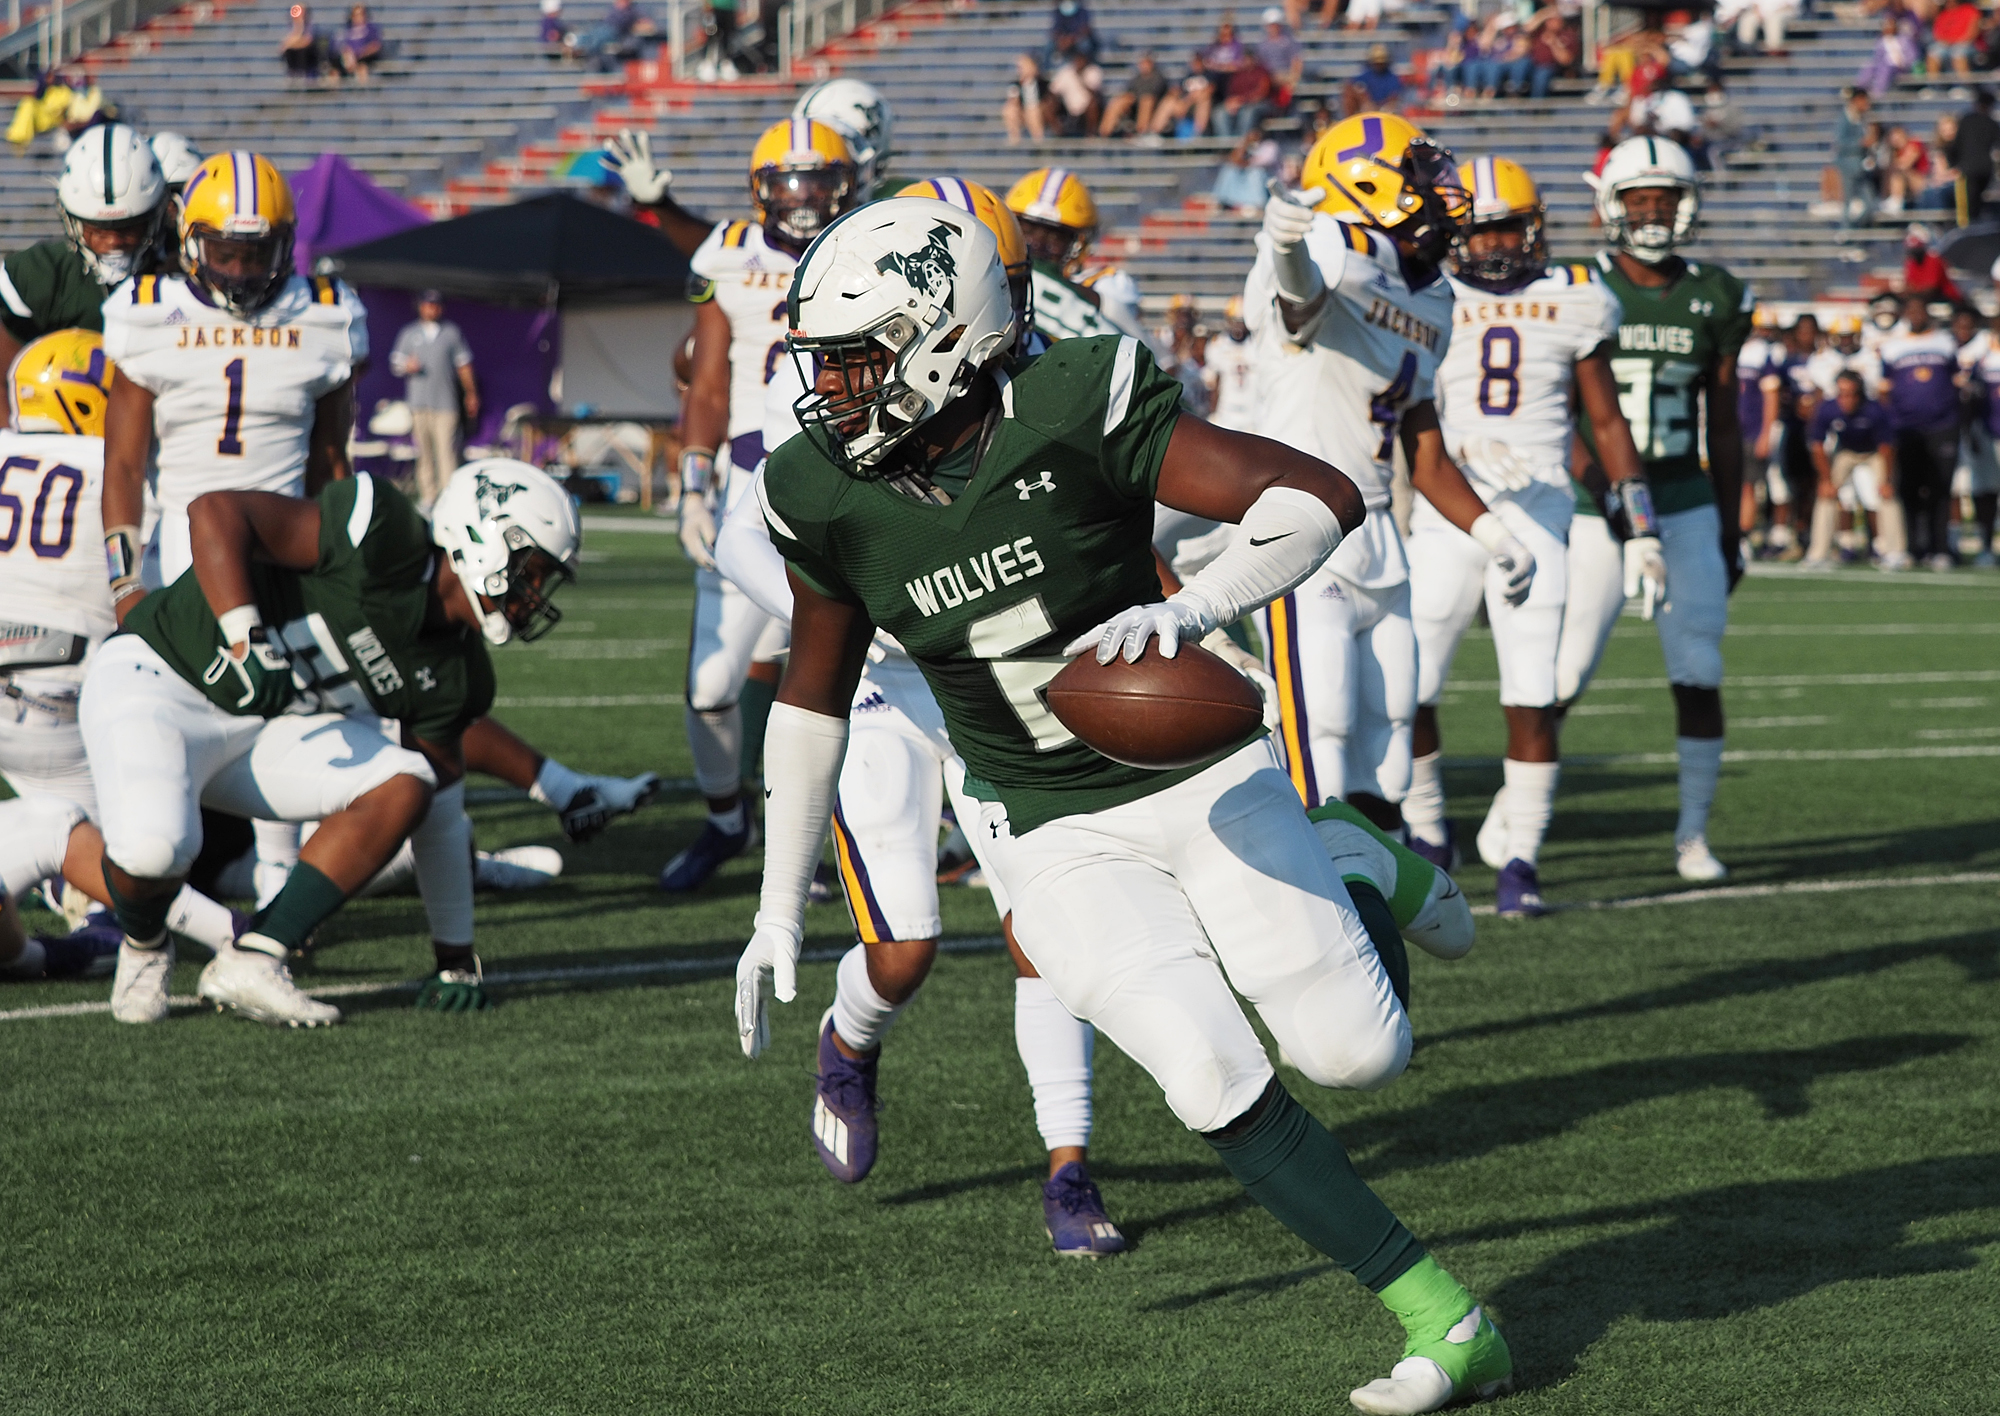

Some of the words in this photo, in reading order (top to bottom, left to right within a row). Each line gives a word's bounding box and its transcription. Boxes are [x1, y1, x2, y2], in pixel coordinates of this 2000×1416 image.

[177, 326, 301, 349] JACKSON
[1459, 303, 1559, 323] ACKSON
[1618, 324, 1694, 355] WOLVES
[216, 357, 246, 457] 1
[1369, 348, 1419, 463] 4
[1480, 324, 1521, 417] 8
[0, 455, 84, 559] 50
[904, 535, 1046, 618] WOLVES
[346, 625, 405, 697] WOLVES
